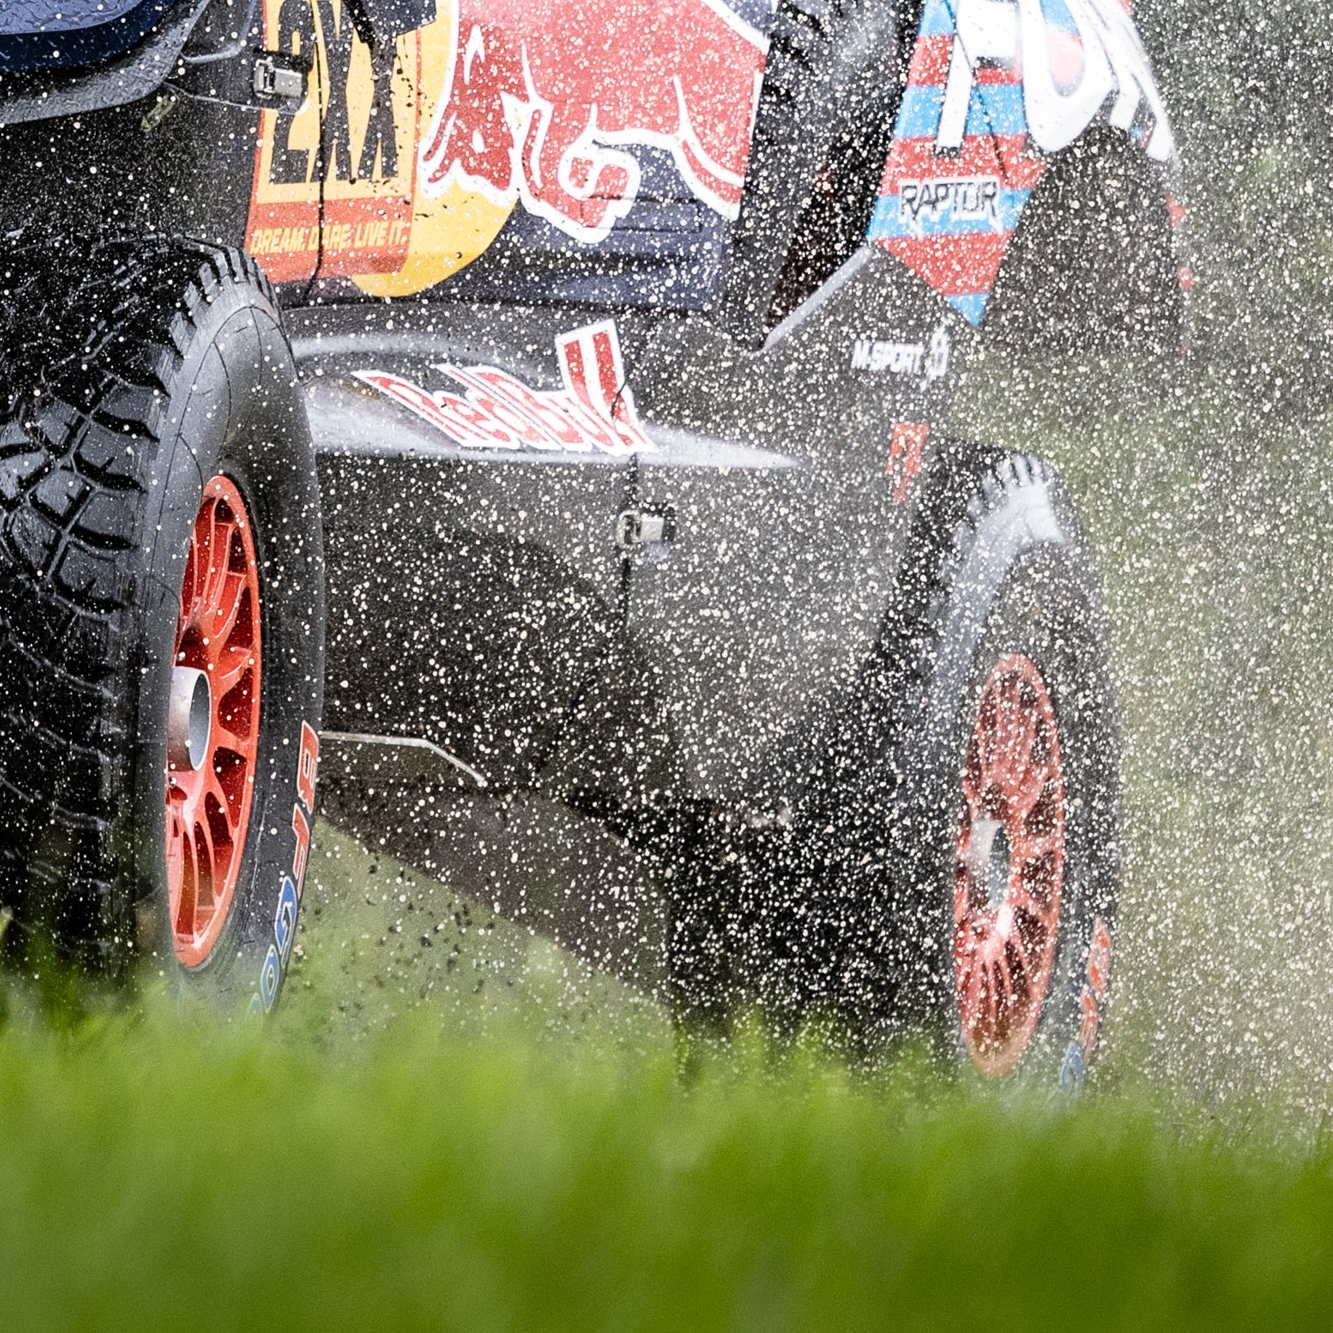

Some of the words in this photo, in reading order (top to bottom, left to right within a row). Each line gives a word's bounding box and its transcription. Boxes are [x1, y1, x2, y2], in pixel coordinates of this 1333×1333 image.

[898, 178, 1001, 232] RAPTOR
[353, 220, 389, 249] LIVE
[850, 338, 925, 374] M-SPORT
